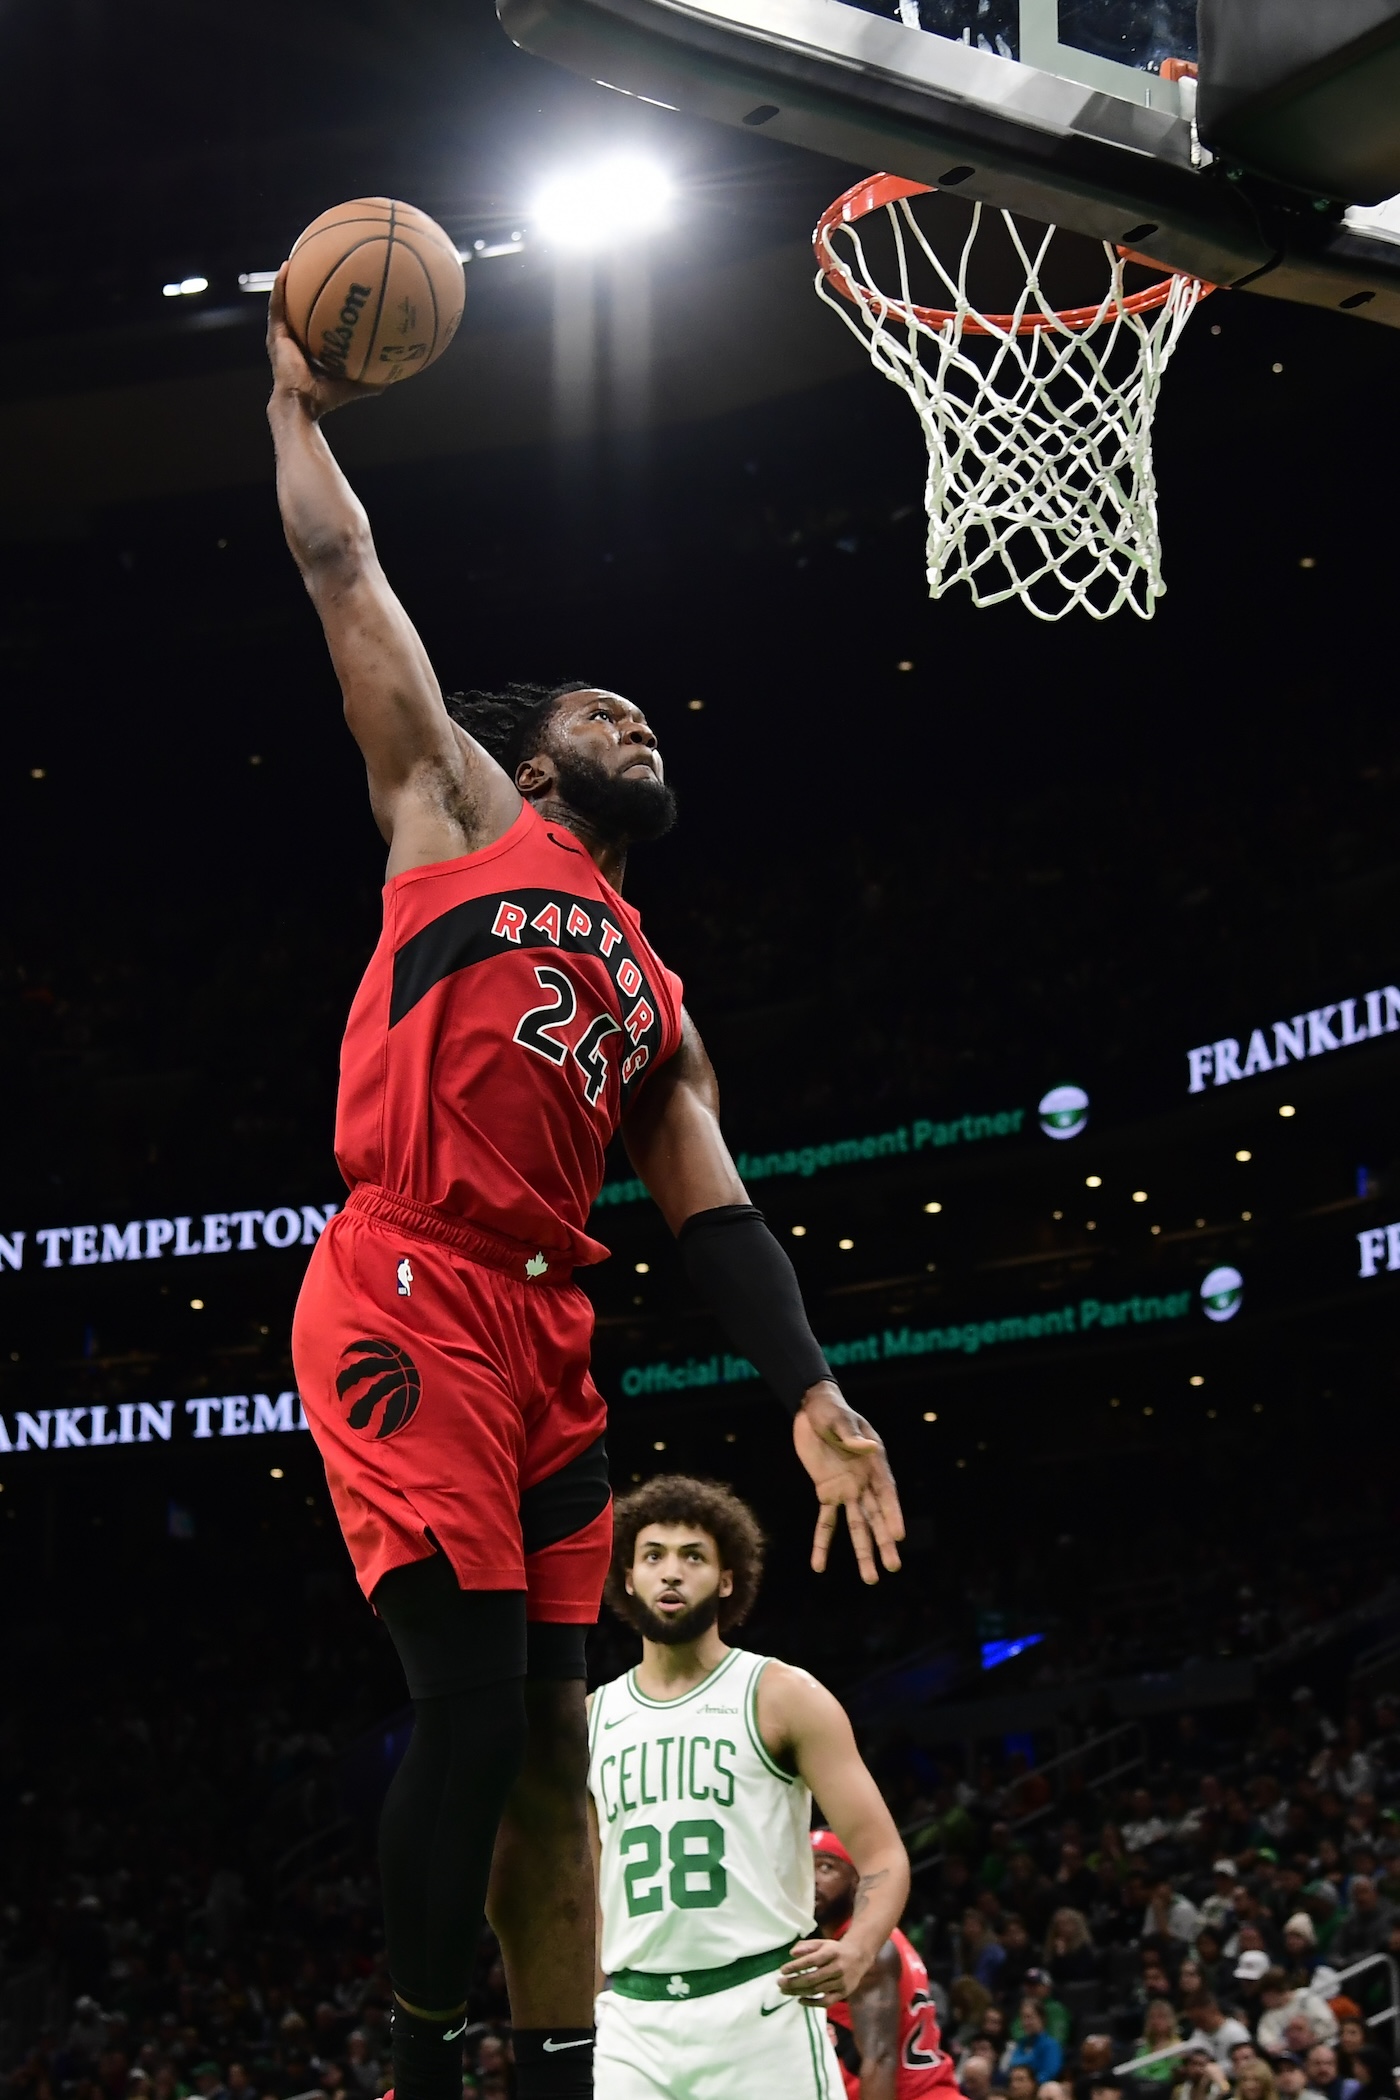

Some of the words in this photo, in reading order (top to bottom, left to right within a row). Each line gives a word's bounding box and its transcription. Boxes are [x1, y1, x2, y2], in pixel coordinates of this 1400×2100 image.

[491, 901, 654, 1084] RAPTORS
[512, 965, 622, 1107] 24
[912, 1108, 1025, 1149] Partner
[36, 1203, 338, 1269] TEMPLETON
[620, 1353, 718, 1397] Official
[883, 1305, 1077, 1354] Management
[1080, 1290, 1192, 1331] Partner
[186, 1391, 310, 1438] TEM
[600, 1735, 736, 1824] CELTICS
[619, 1818, 727, 1919] 28
